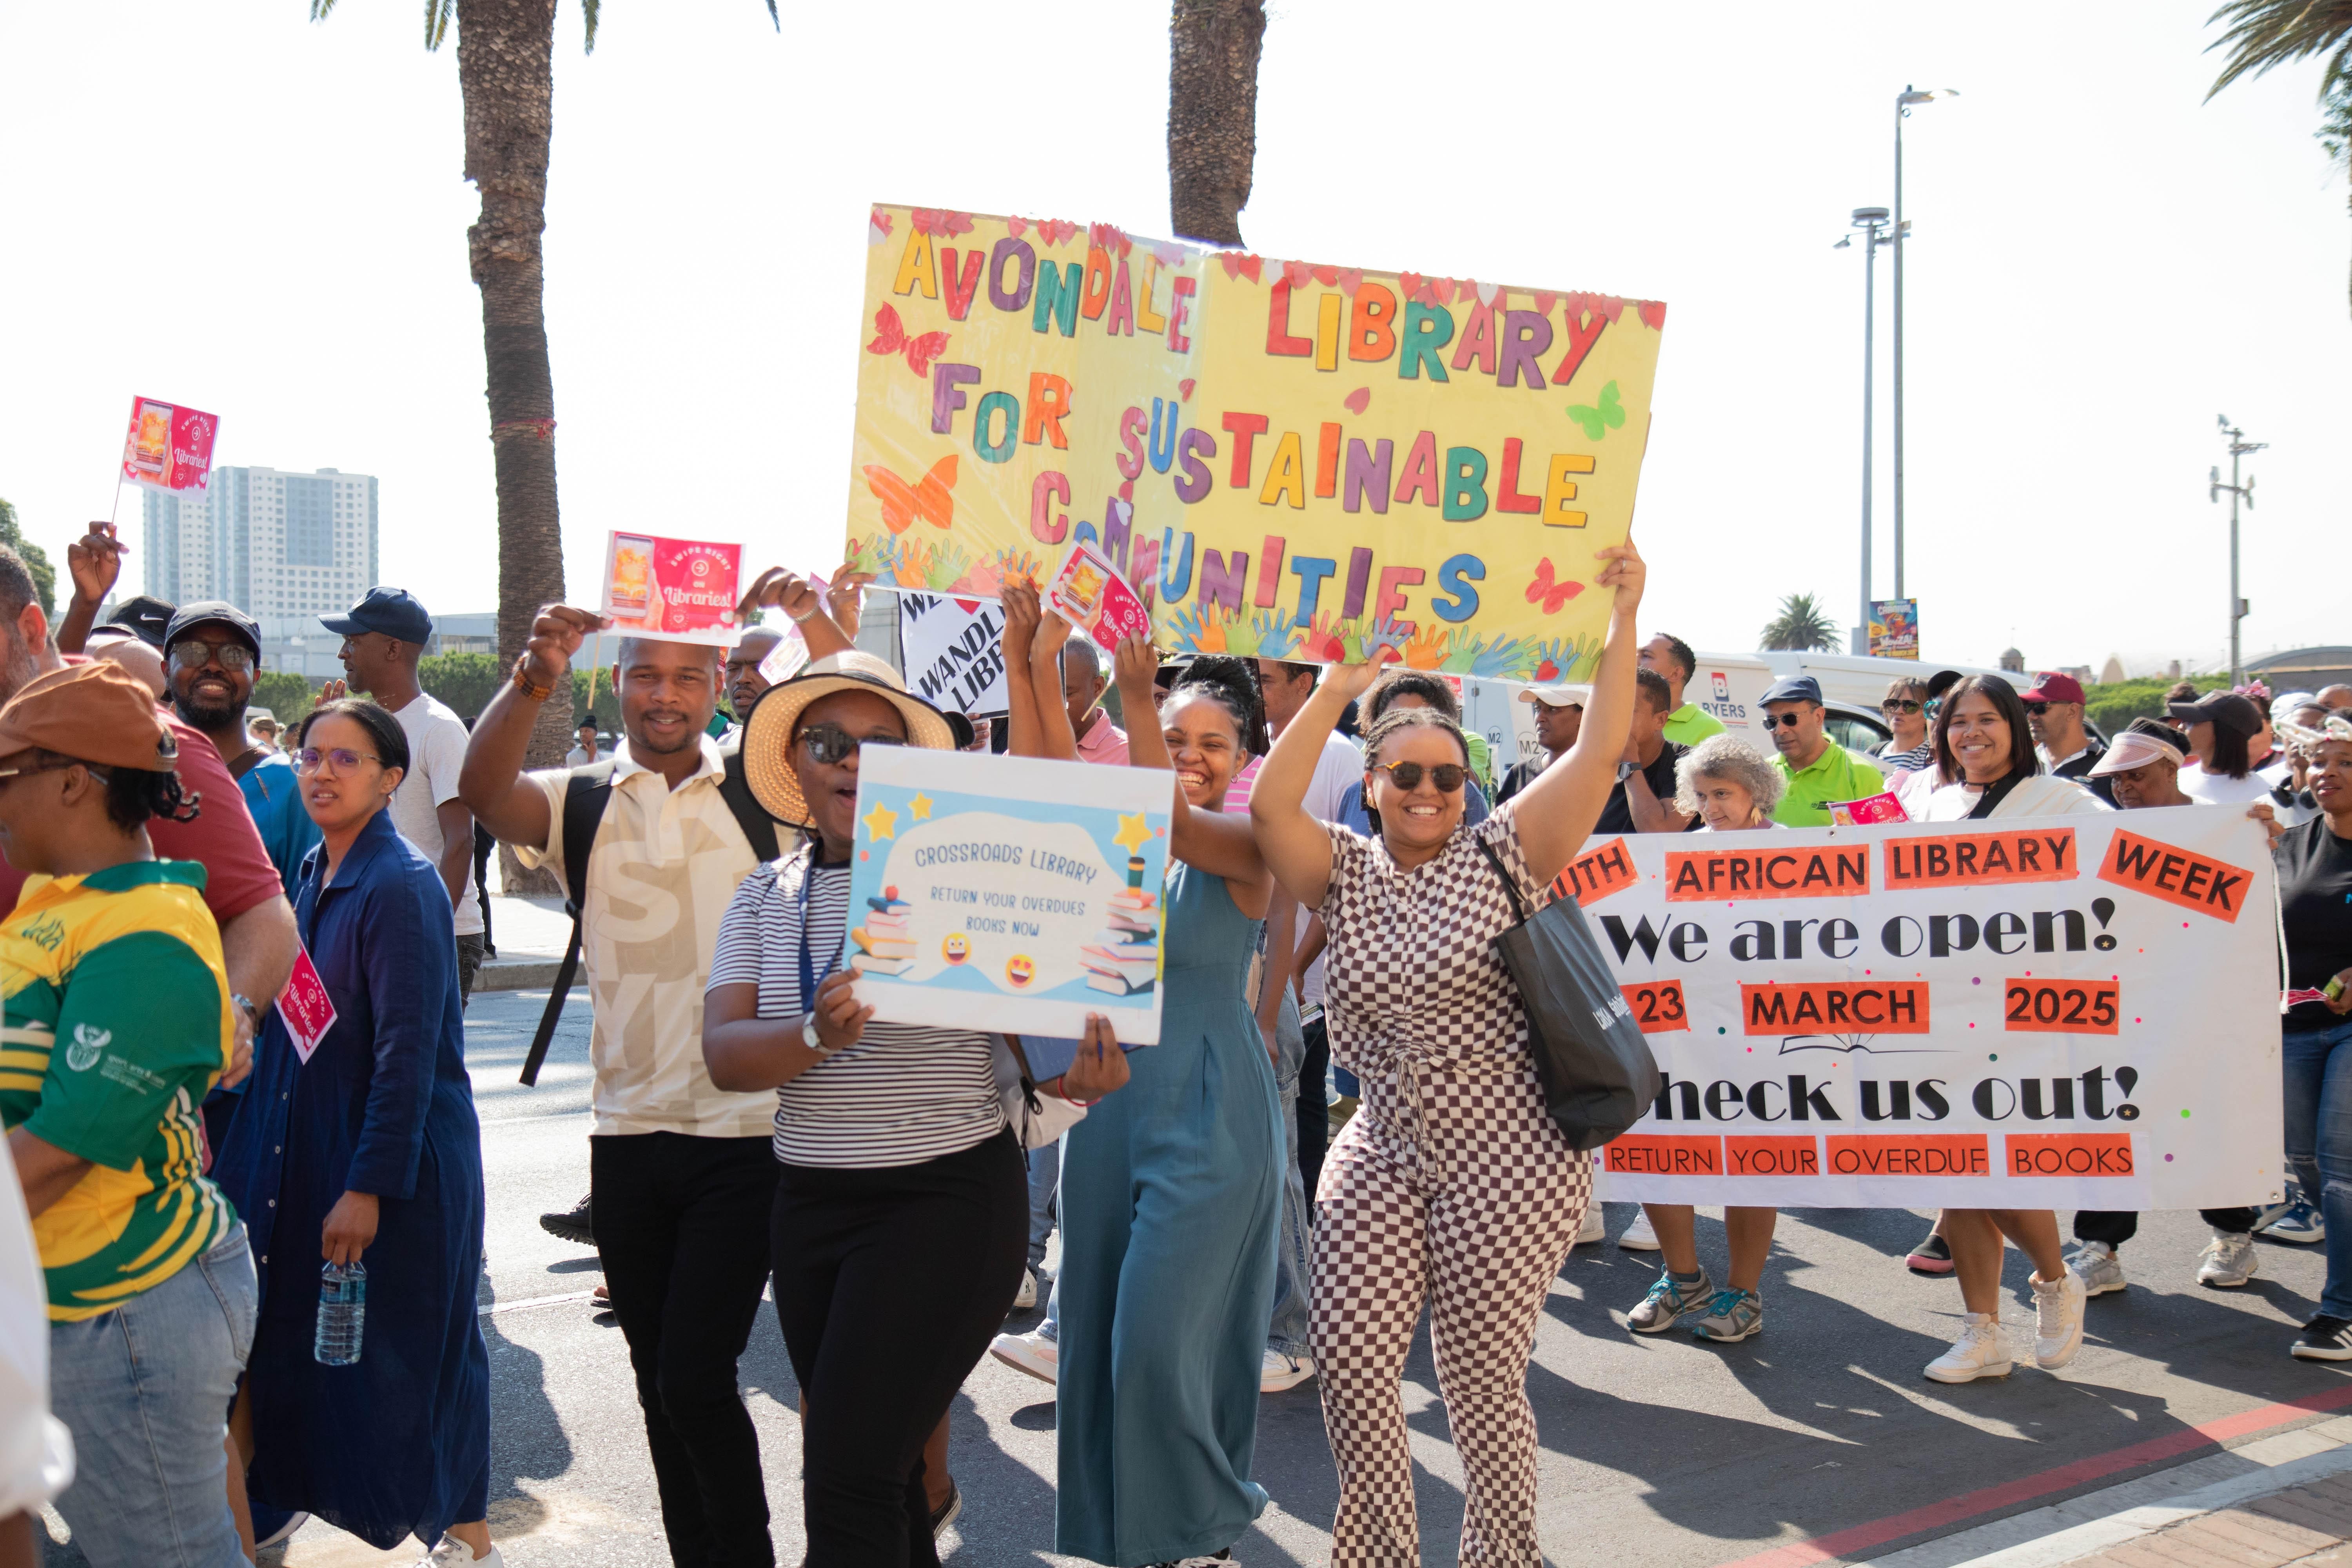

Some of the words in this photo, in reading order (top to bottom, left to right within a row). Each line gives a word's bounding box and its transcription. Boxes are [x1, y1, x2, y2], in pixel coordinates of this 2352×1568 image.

[893, 227, 1196, 354] AVONDALE
[1265, 278, 1609, 390] LIBRARY
[181, 415, 198, 431] SWIPE
[174, 448, 208, 469] Libraries!
[931, 363, 1073, 464] FOR
[1116, 397, 1595, 528] SUSTAINABLE
[670, 546, 701, 567] SWIPE
[663, 585, 732, 608] Libraries!
[918, 605, 1004, 701] WANDL
[1488, 733, 1501, 744] M2
[1519, 740, 1540, 754] M2
[915, 842, 1023, 868] CROSSROADS
[1030, 849, 1097, 885] LIBRARY
[1554, 846, 1628, 898] UTH
[1674, 853, 1865, 893] AFRICAN
[1893, 835, 2070, 879] LIBRARY
[2115, 839, 2242, 912] WEEK
[930, 886, 978, 905] RETURN
[984, 891, 1017, 909] YOUR
[1022, 896, 1085, 916] OVERDUES
[965, 916, 1007, 934] BOOKS
[1012, 921, 1040, 937] NOW
[1599, 913, 1708, 966] We
[1730, 918, 1859, 962] are
[1881, 897, 2118, 958] open!
[290, 983, 317, 1037] Libraries!
[1636, 987, 1684, 1023] 23
[1751, 989, 1916, 1025] MARCH
[2007, 987, 2116, 1026] 2025
[1638, 1072, 1842, 1122] heck
[1859, 1078, 1950, 1122] us
[1972, 1065, 2140, 1122] out!
[1610, 1149, 1713, 1173] RETURN
[1733, 1149, 1816, 1174] YOUR
[1834, 1148, 1986, 1174] OVERDUE
[2015, 1147, 2132, 1174] BOOKS
